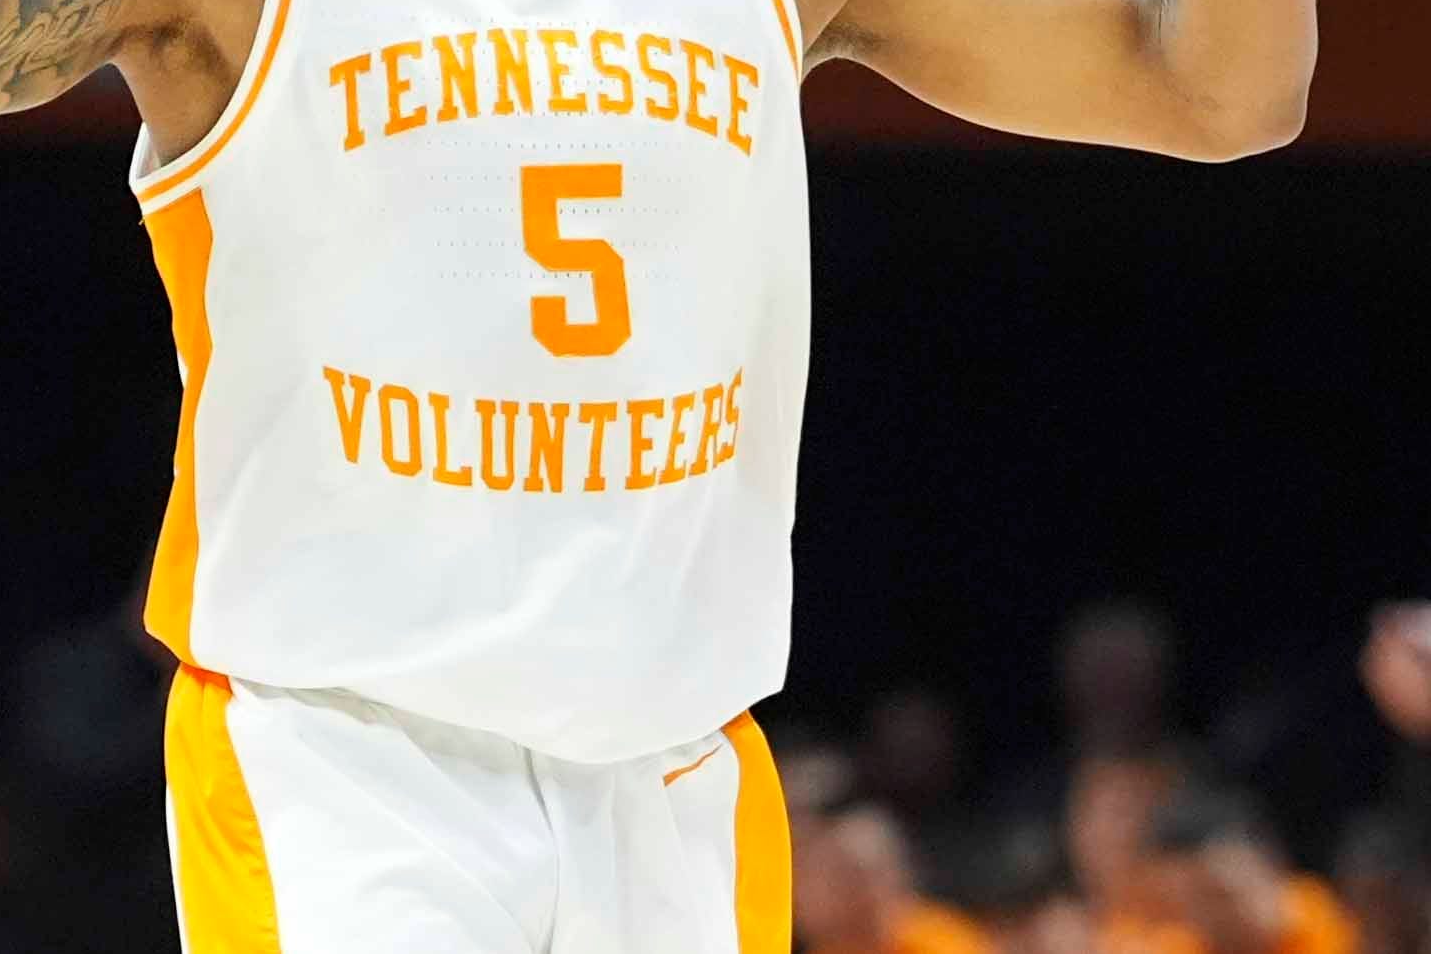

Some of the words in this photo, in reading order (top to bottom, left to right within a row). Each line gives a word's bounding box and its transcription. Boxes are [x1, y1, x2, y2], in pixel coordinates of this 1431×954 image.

[329, 28, 759, 156] TENNESSEE
[520, 162, 632, 358] 5
[322, 365, 743, 493] VOLUNTEERS
